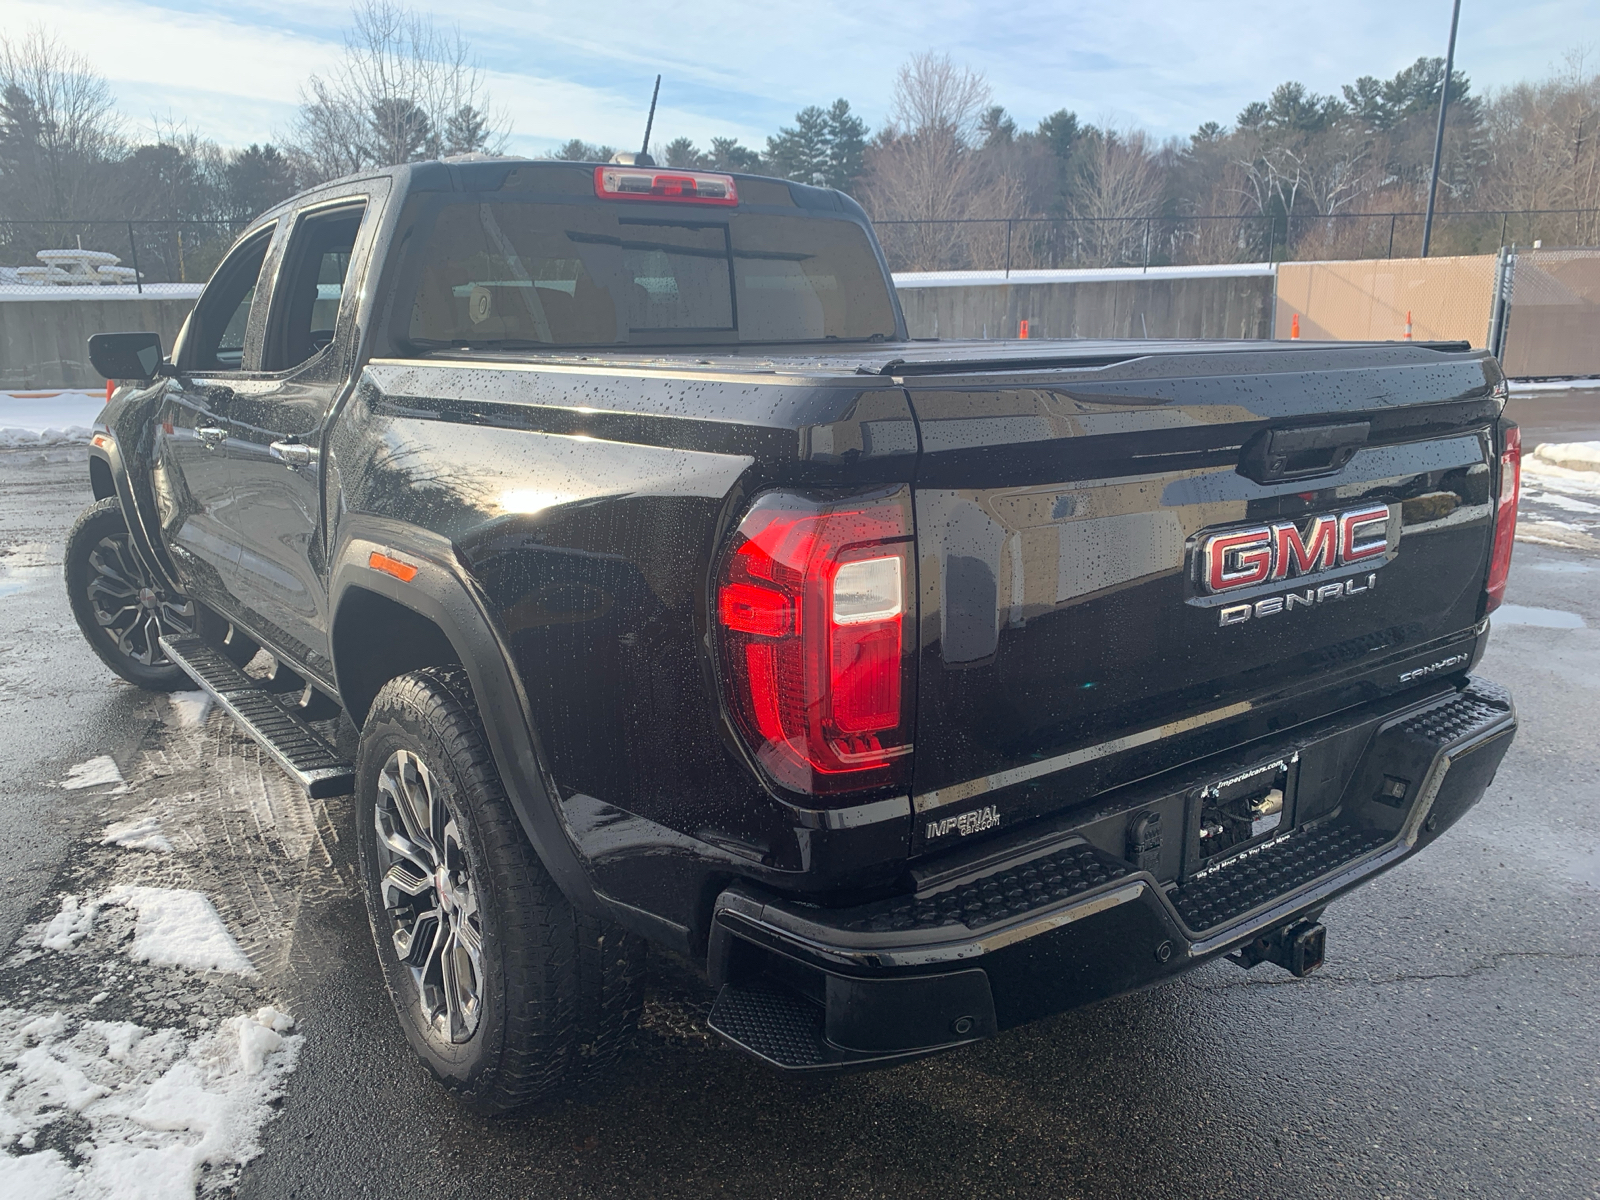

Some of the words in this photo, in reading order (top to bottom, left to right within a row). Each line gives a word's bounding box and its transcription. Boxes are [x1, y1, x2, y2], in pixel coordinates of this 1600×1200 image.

[1203, 502, 1390, 594] GMC
[1218, 572, 1377, 627] DENALI
[1398, 652, 1469, 683] CANYON
[1216, 759, 1284, 790] Imperialcars.com
[925, 803, 1001, 839] IMPERIAL
[960, 815, 1001, 837] cars.com
